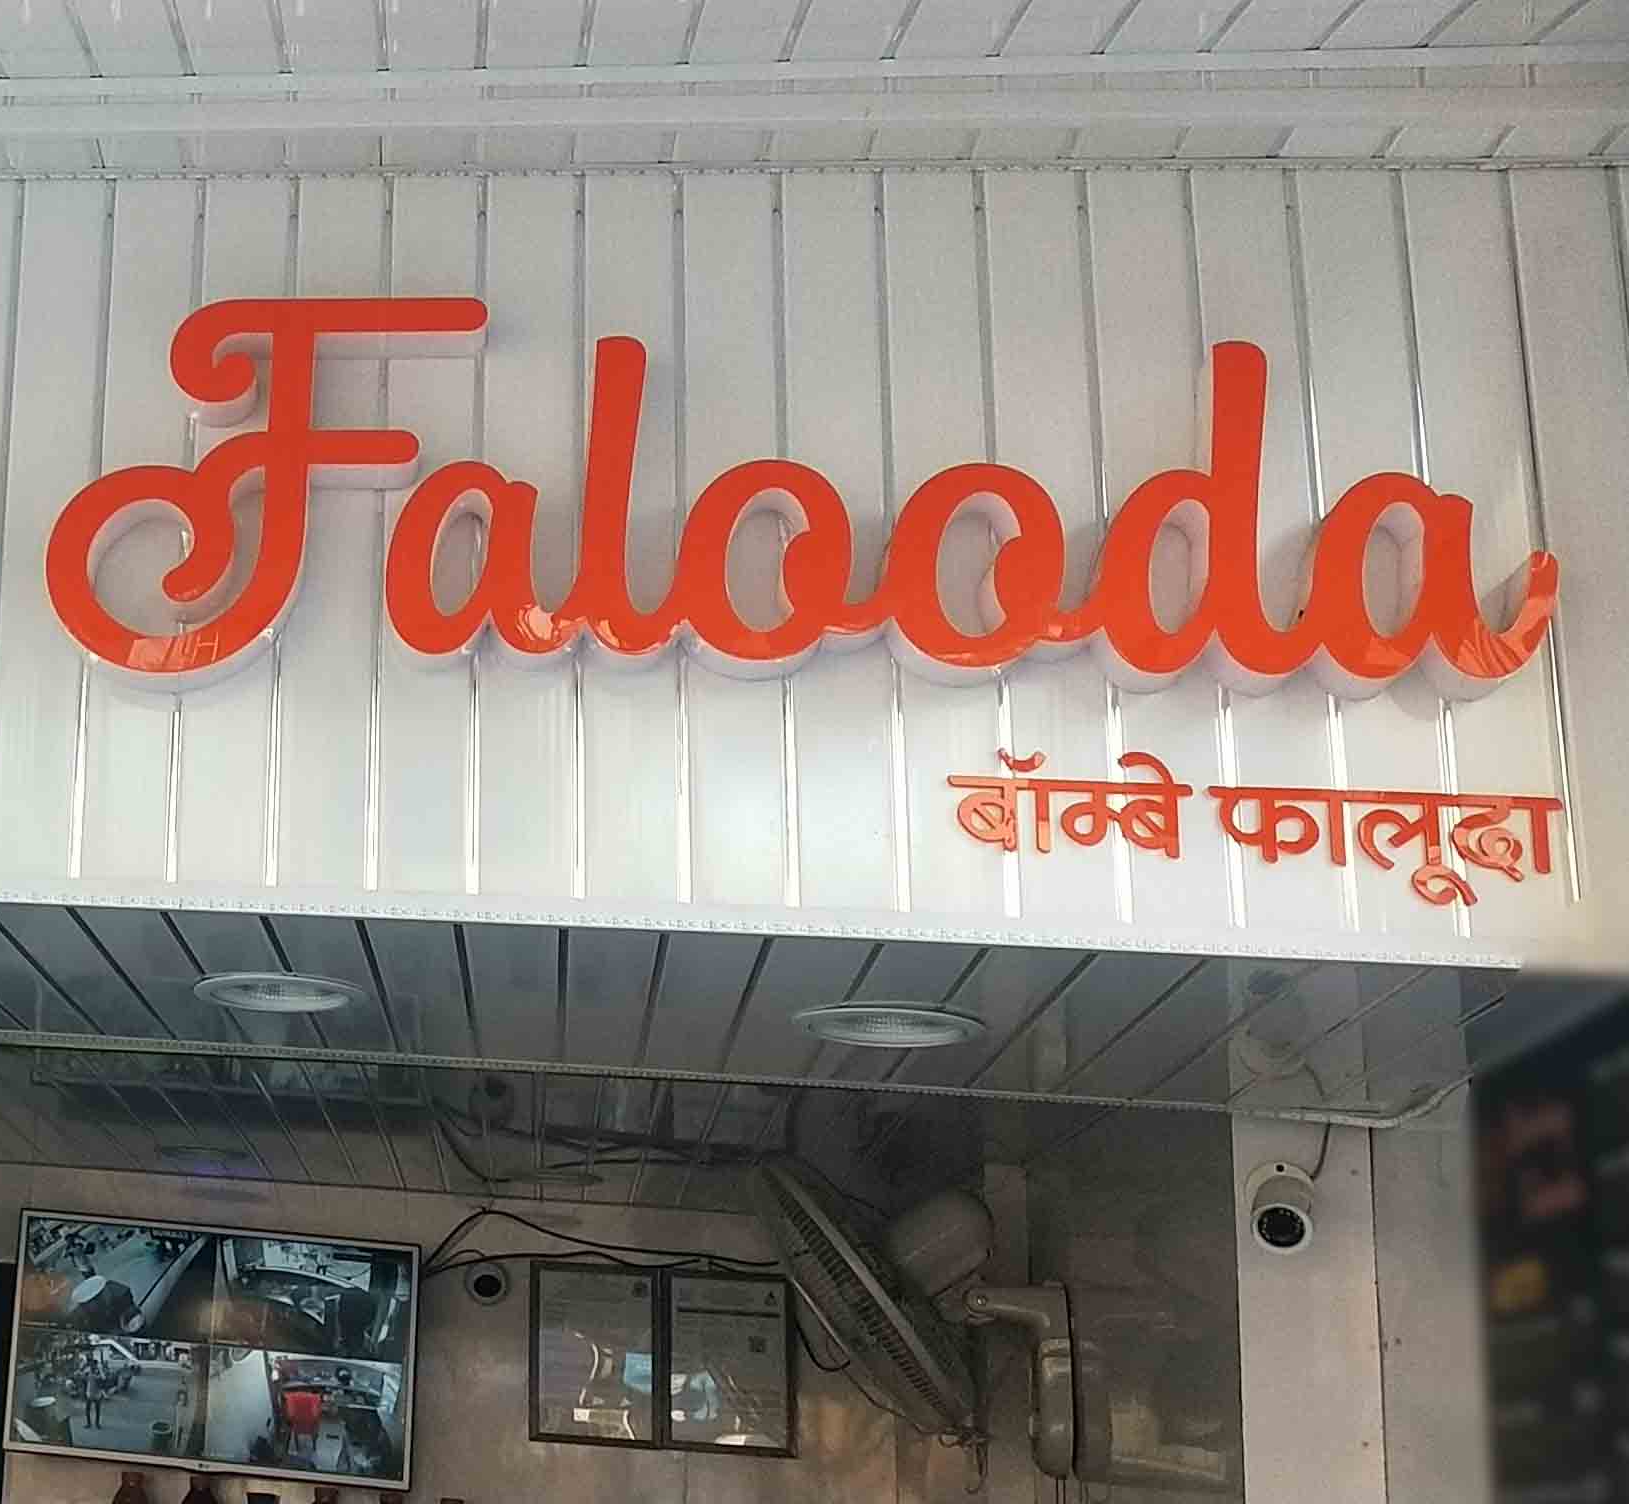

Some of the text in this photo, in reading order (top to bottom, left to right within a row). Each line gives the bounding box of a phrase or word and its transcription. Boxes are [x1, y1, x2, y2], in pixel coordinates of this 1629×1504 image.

[45, 297, 1560, 680] Falooda
[947, 749, 1564, 907] बॉम्बे फालूदा
